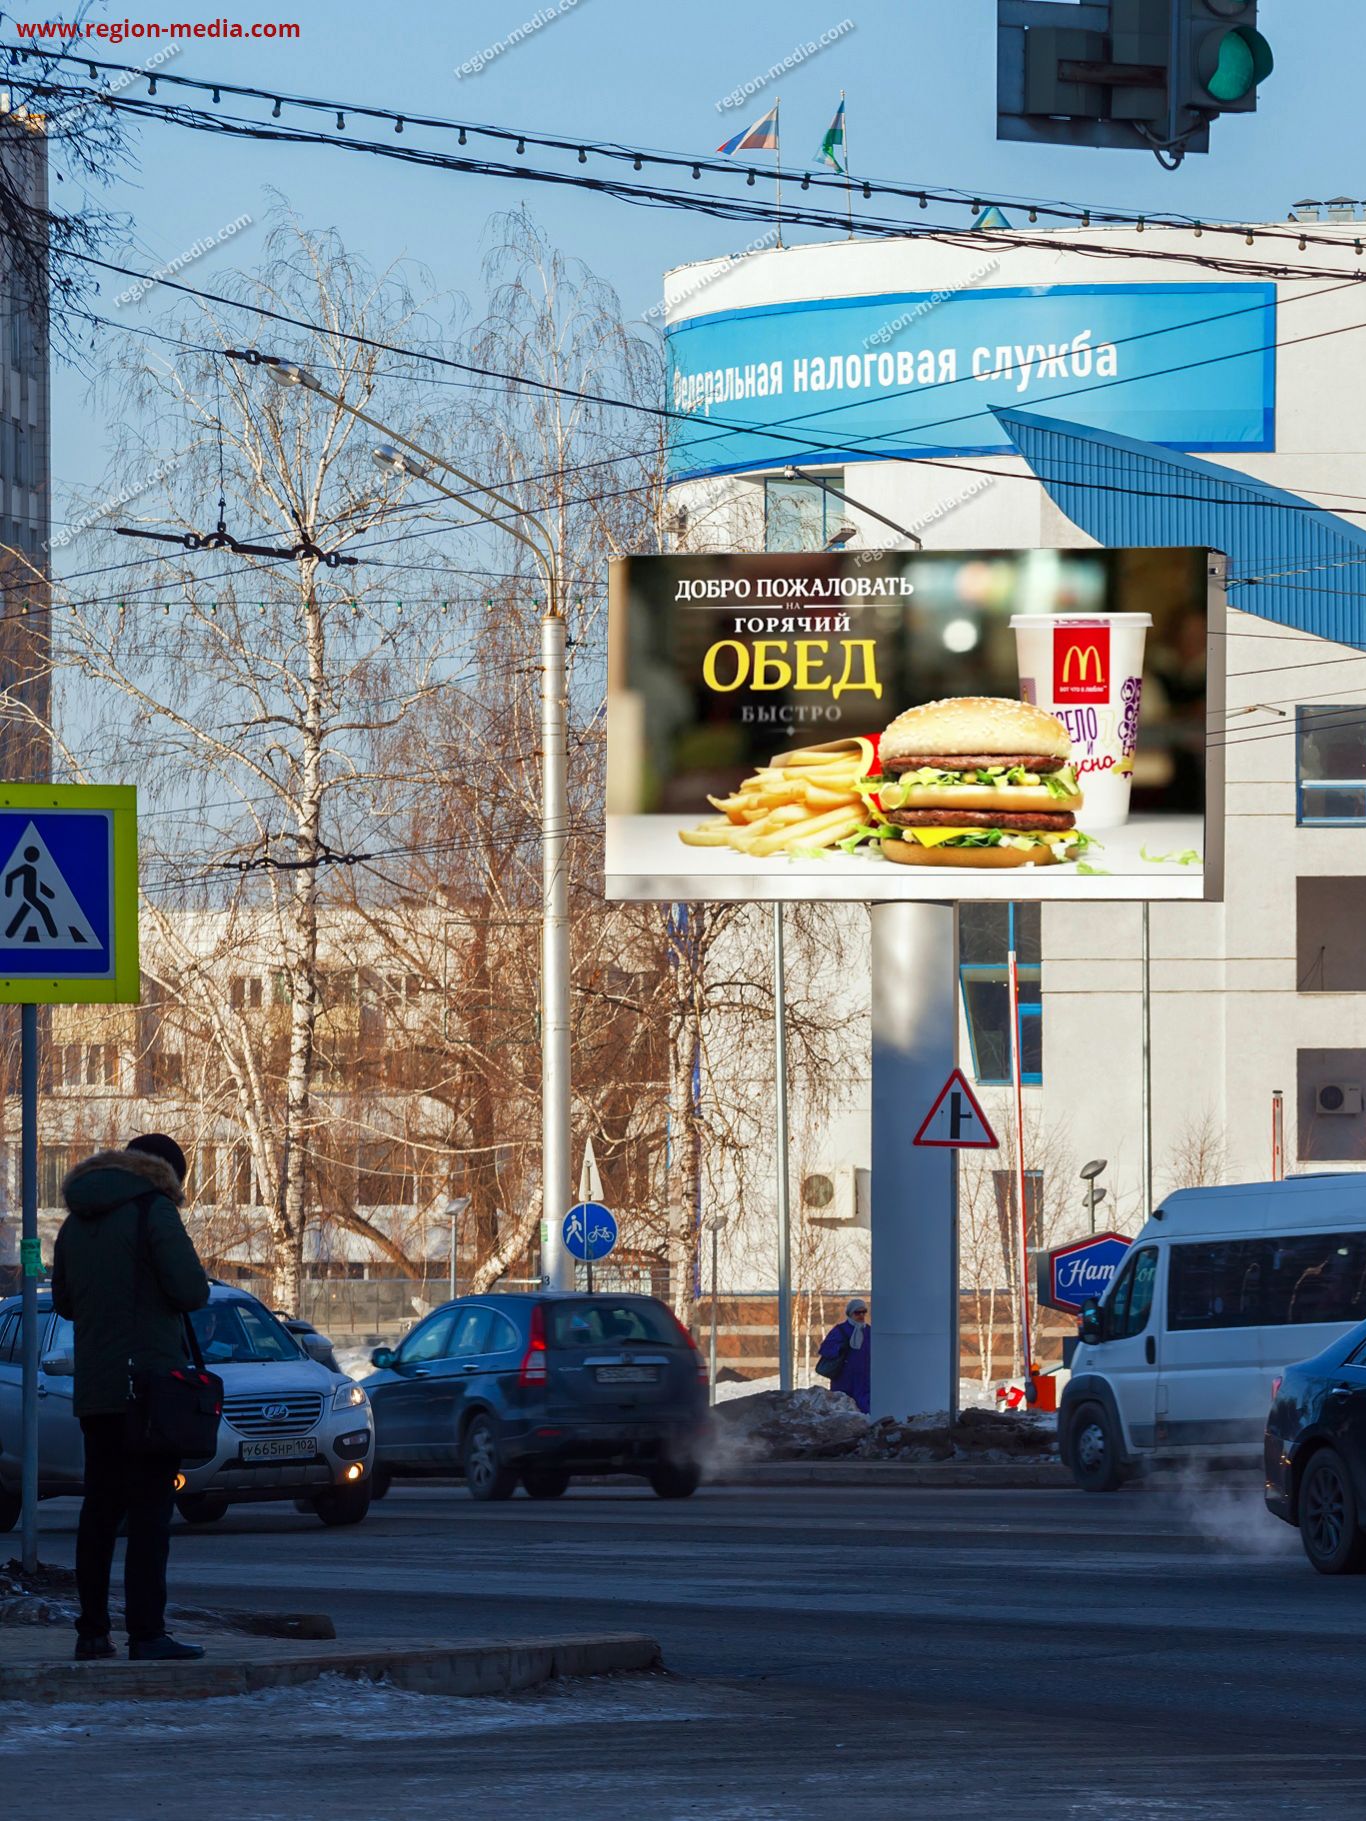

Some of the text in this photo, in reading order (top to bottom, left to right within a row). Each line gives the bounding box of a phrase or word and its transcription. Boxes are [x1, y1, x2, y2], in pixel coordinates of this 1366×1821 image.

[793, 348, 957, 393] налоговая
[972, 329, 1119, 393] служба
[675, 577, 914, 601] ДОБРО ПОЖАЛОВАТЬ
[785, 602, 801, 610] НА
[734, 613, 851, 633] ГОРЯЧИЙ
[703, 639, 883, 700] ОБЕД
[742, 705, 842, 723] БЫСТРО
[295, 1440, 314, 1450] 102
